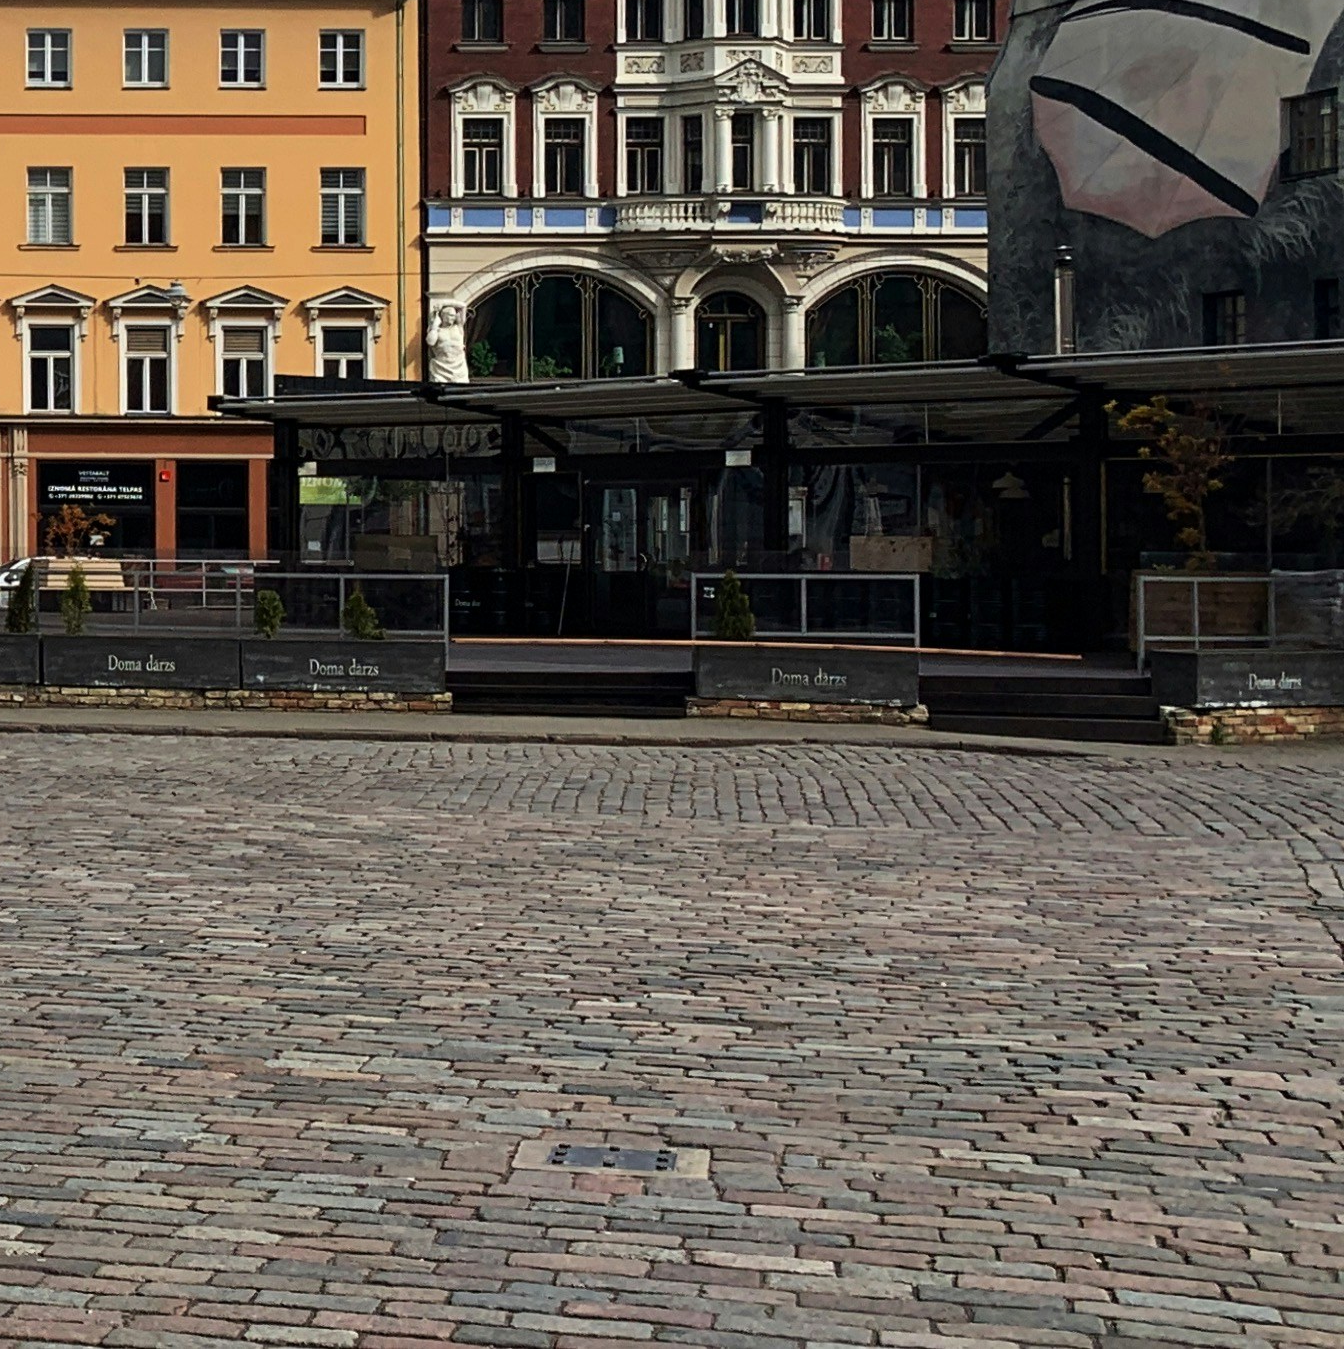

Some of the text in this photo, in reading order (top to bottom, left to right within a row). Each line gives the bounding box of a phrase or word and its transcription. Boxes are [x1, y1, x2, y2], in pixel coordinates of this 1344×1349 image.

[108, 654, 141, 671] Doma
[309, 658, 344, 675] Doma
[772, 667, 809, 685] Doma
